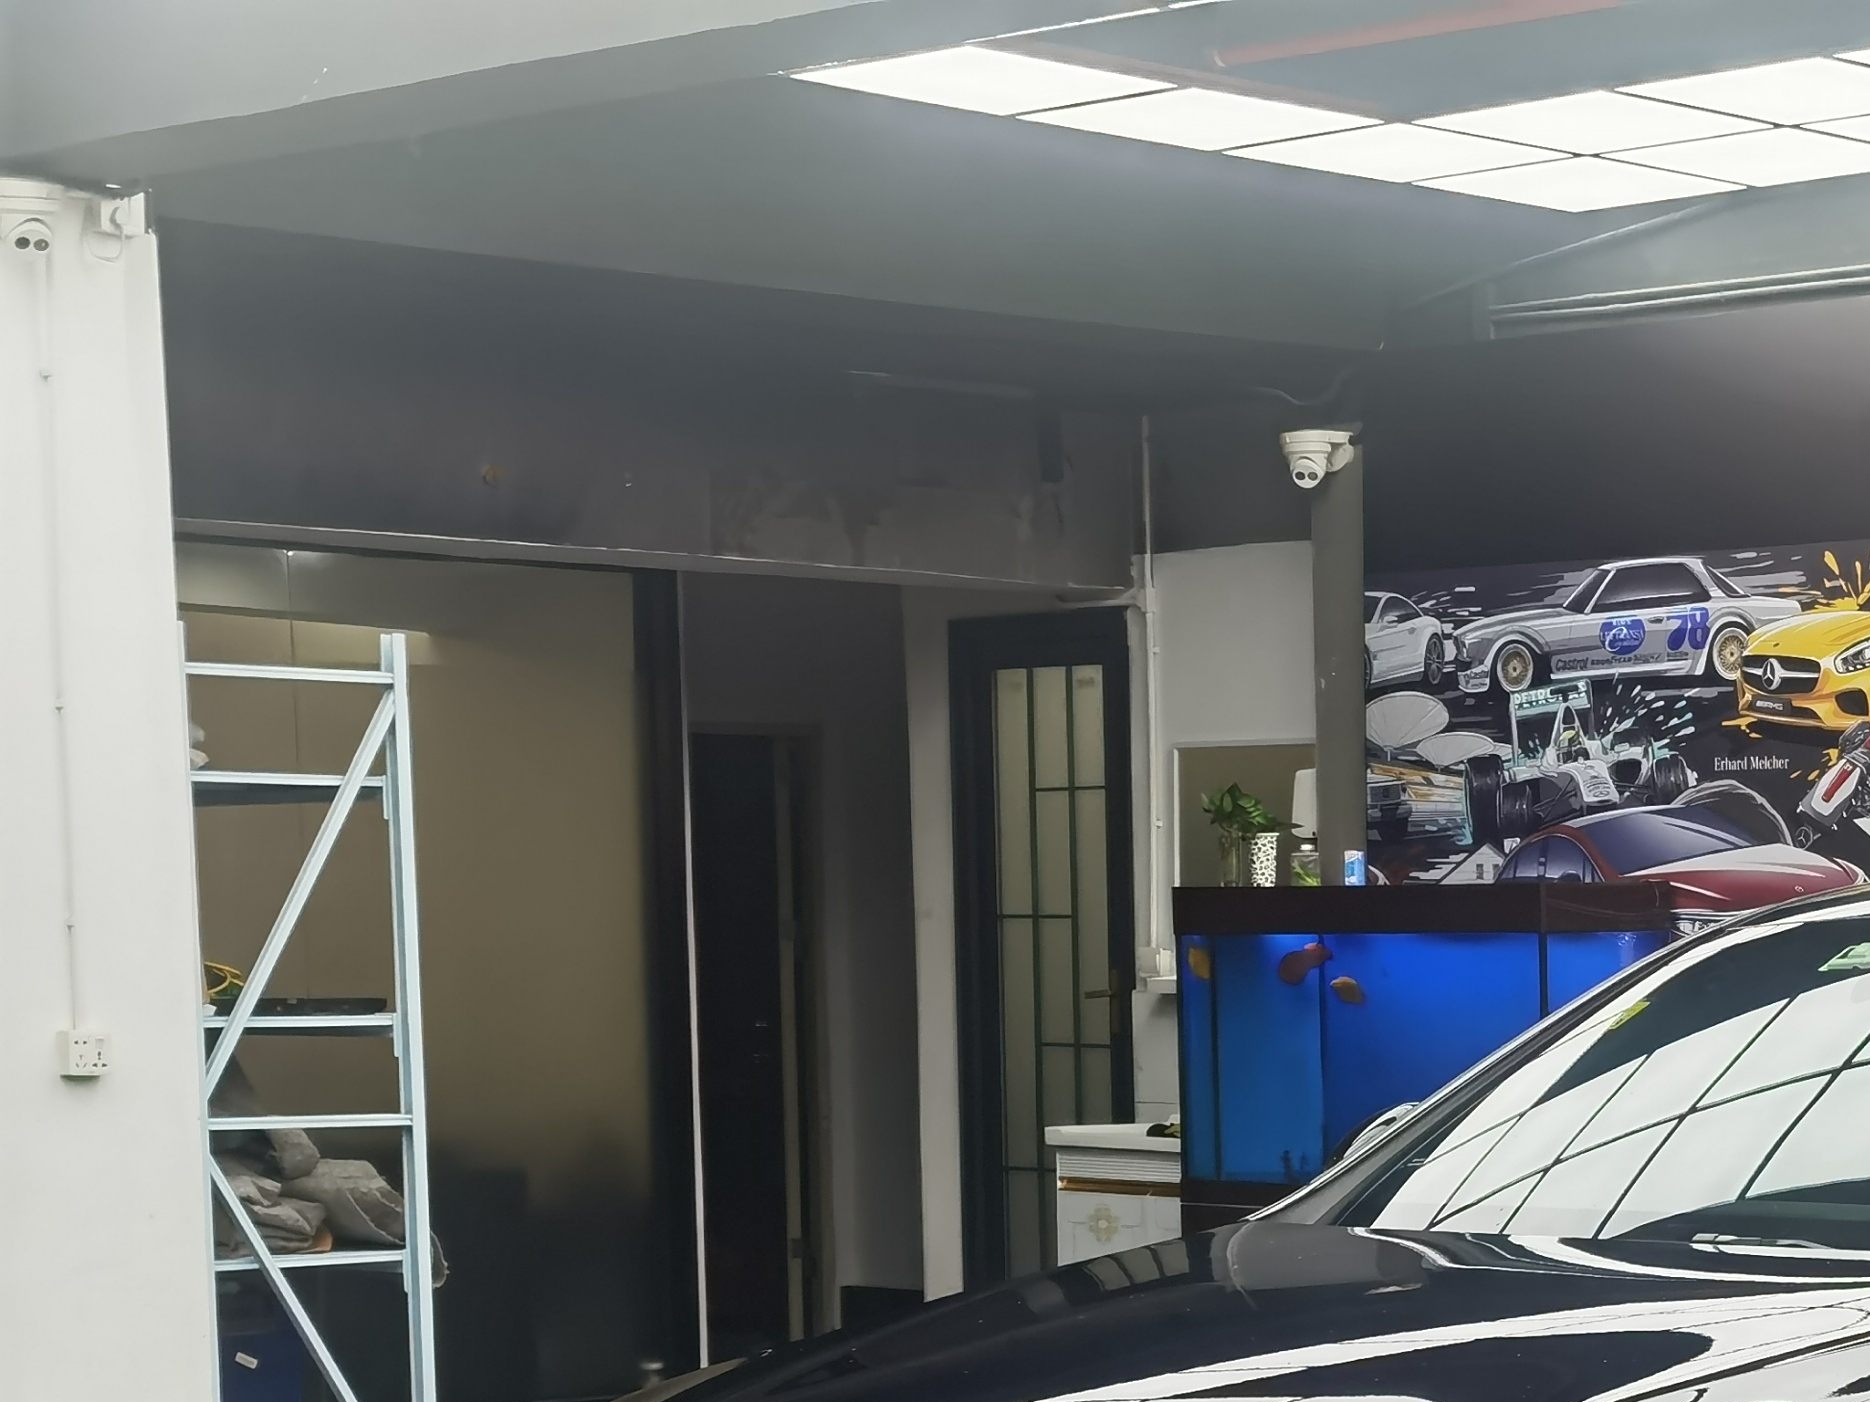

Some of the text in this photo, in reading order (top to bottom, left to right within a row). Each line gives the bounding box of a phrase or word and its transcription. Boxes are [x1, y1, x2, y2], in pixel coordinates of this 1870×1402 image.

[1666, 606, 1711, 652] 78
[1714, 755, 1790, 772] Erhard Melcher
